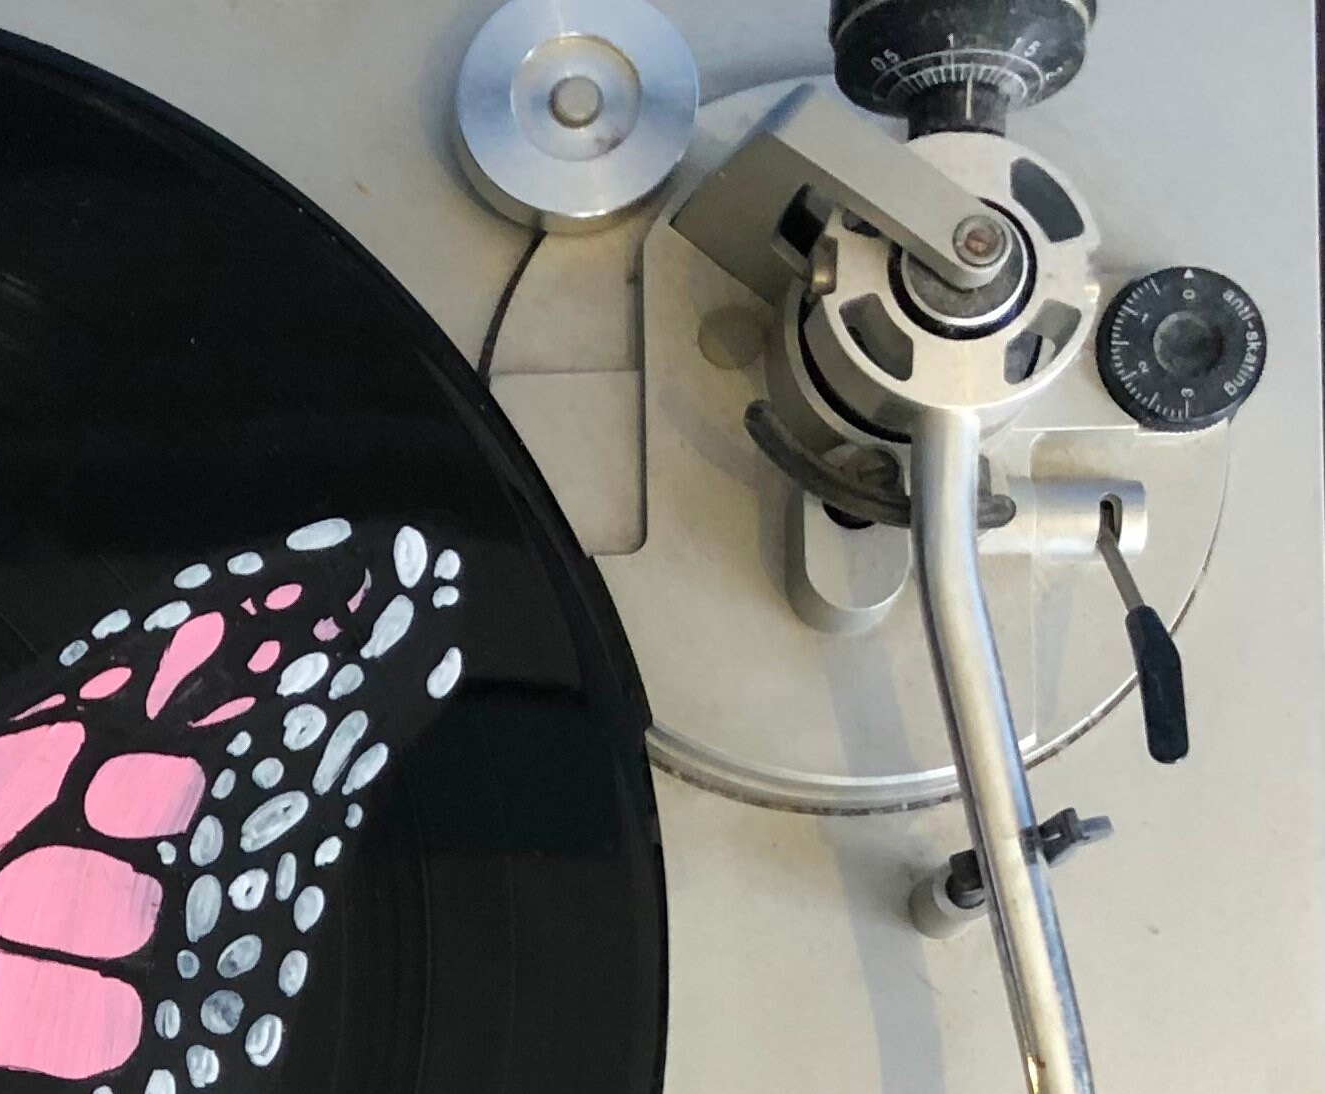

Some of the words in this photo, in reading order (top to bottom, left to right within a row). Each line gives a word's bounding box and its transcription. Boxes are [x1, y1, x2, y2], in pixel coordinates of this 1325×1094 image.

[1182, 288, 1196, 300] 0
[1138, 360, 1150, 374] 2
[1180, 388, 1195, 398] 3
